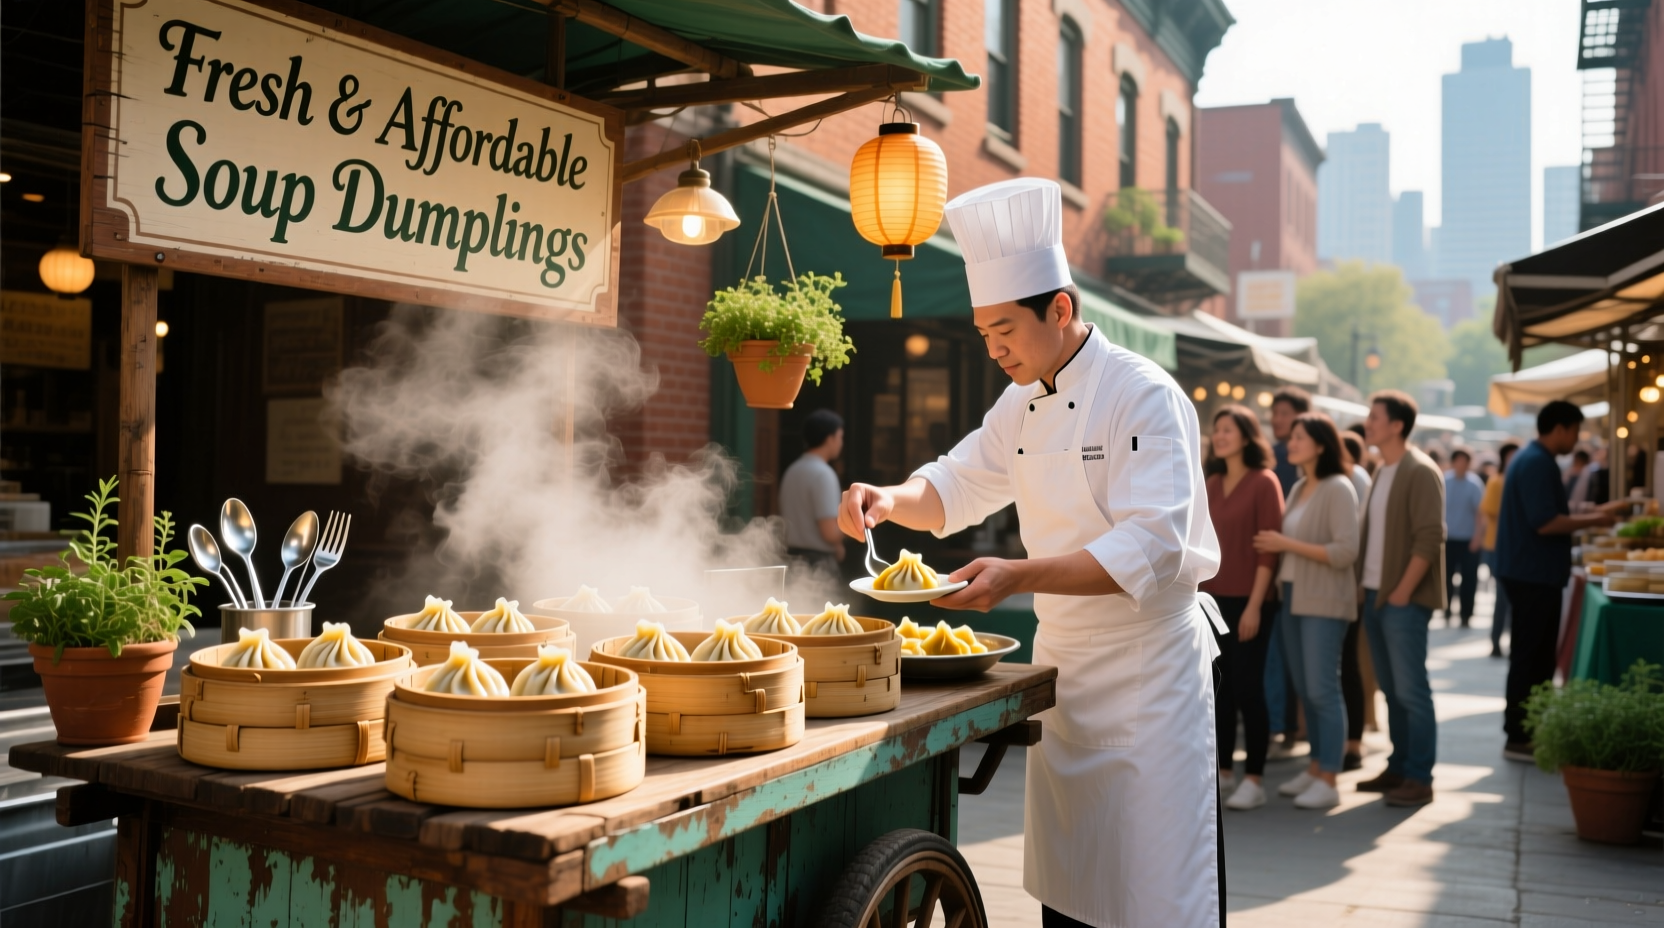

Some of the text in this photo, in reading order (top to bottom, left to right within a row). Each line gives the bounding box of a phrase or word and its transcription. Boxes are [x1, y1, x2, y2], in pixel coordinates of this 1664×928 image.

[158, 19, 588, 190] Fresh & Affordable
[155, 119, 588, 289] Soup Dumplings
